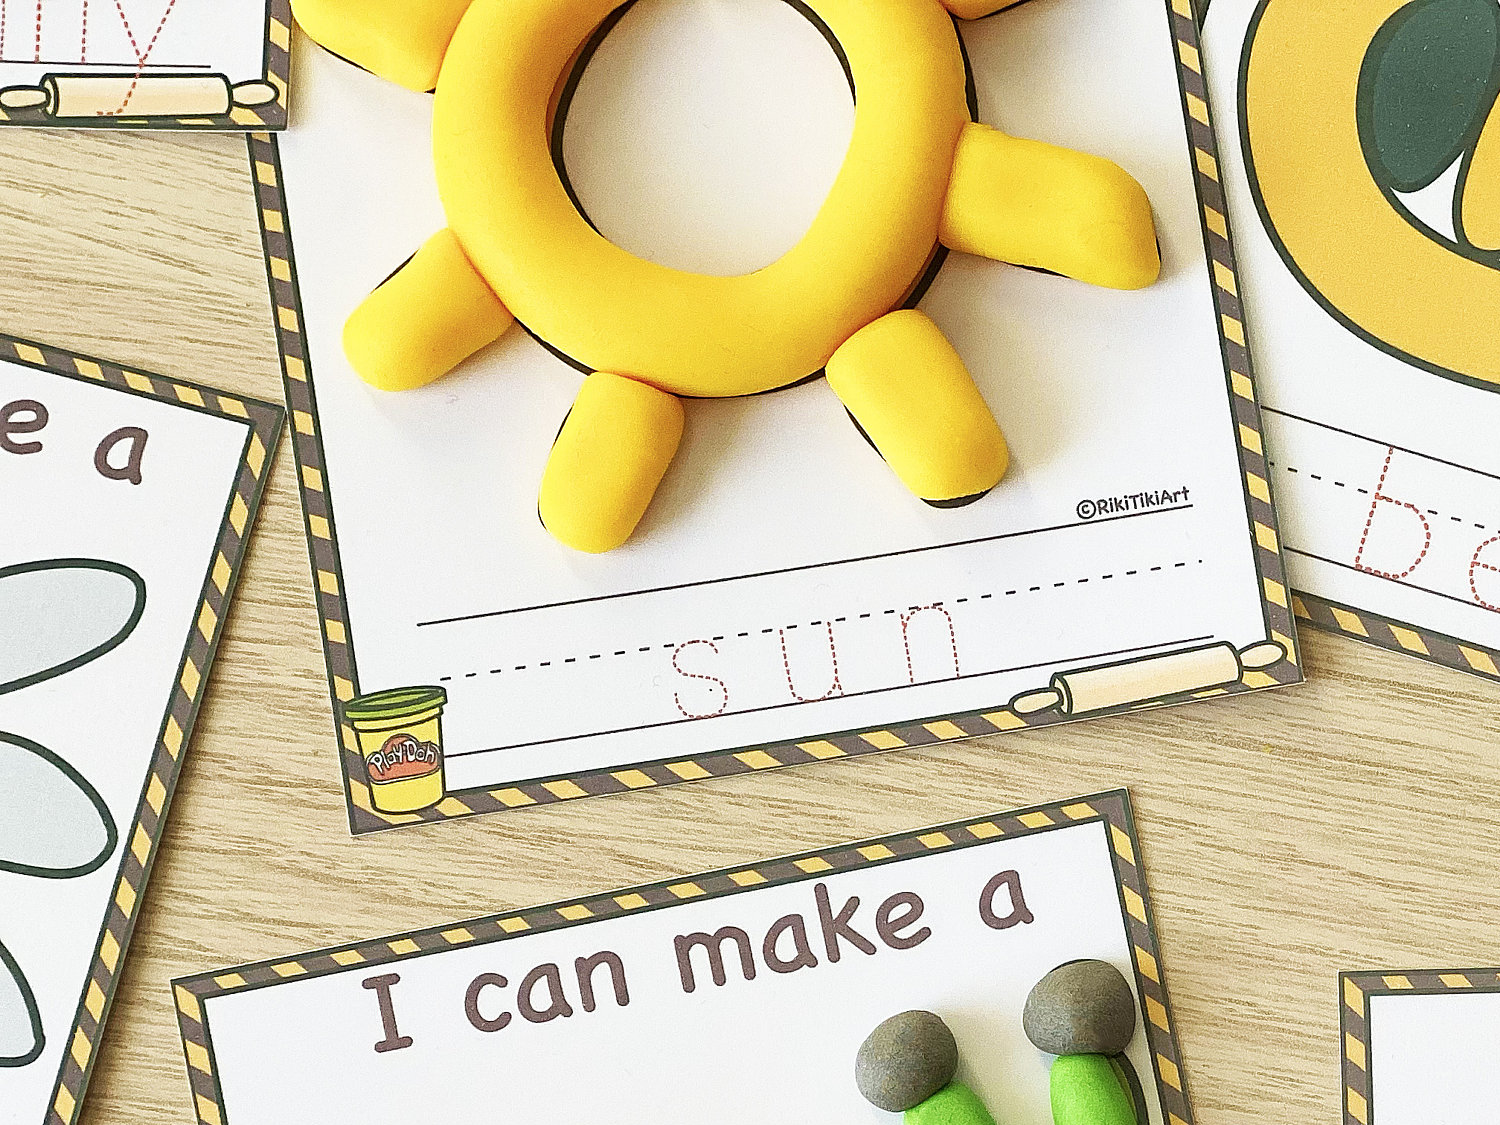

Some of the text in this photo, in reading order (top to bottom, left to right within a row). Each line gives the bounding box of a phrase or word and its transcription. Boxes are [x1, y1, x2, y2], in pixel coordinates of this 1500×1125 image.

[94, 426, 148, 485] a
[1076, 486, 1189, 519] ©RikiTikiArt
[671, 603, 960, 720] sun
[362, 869, 1034, 1053] I can make a
